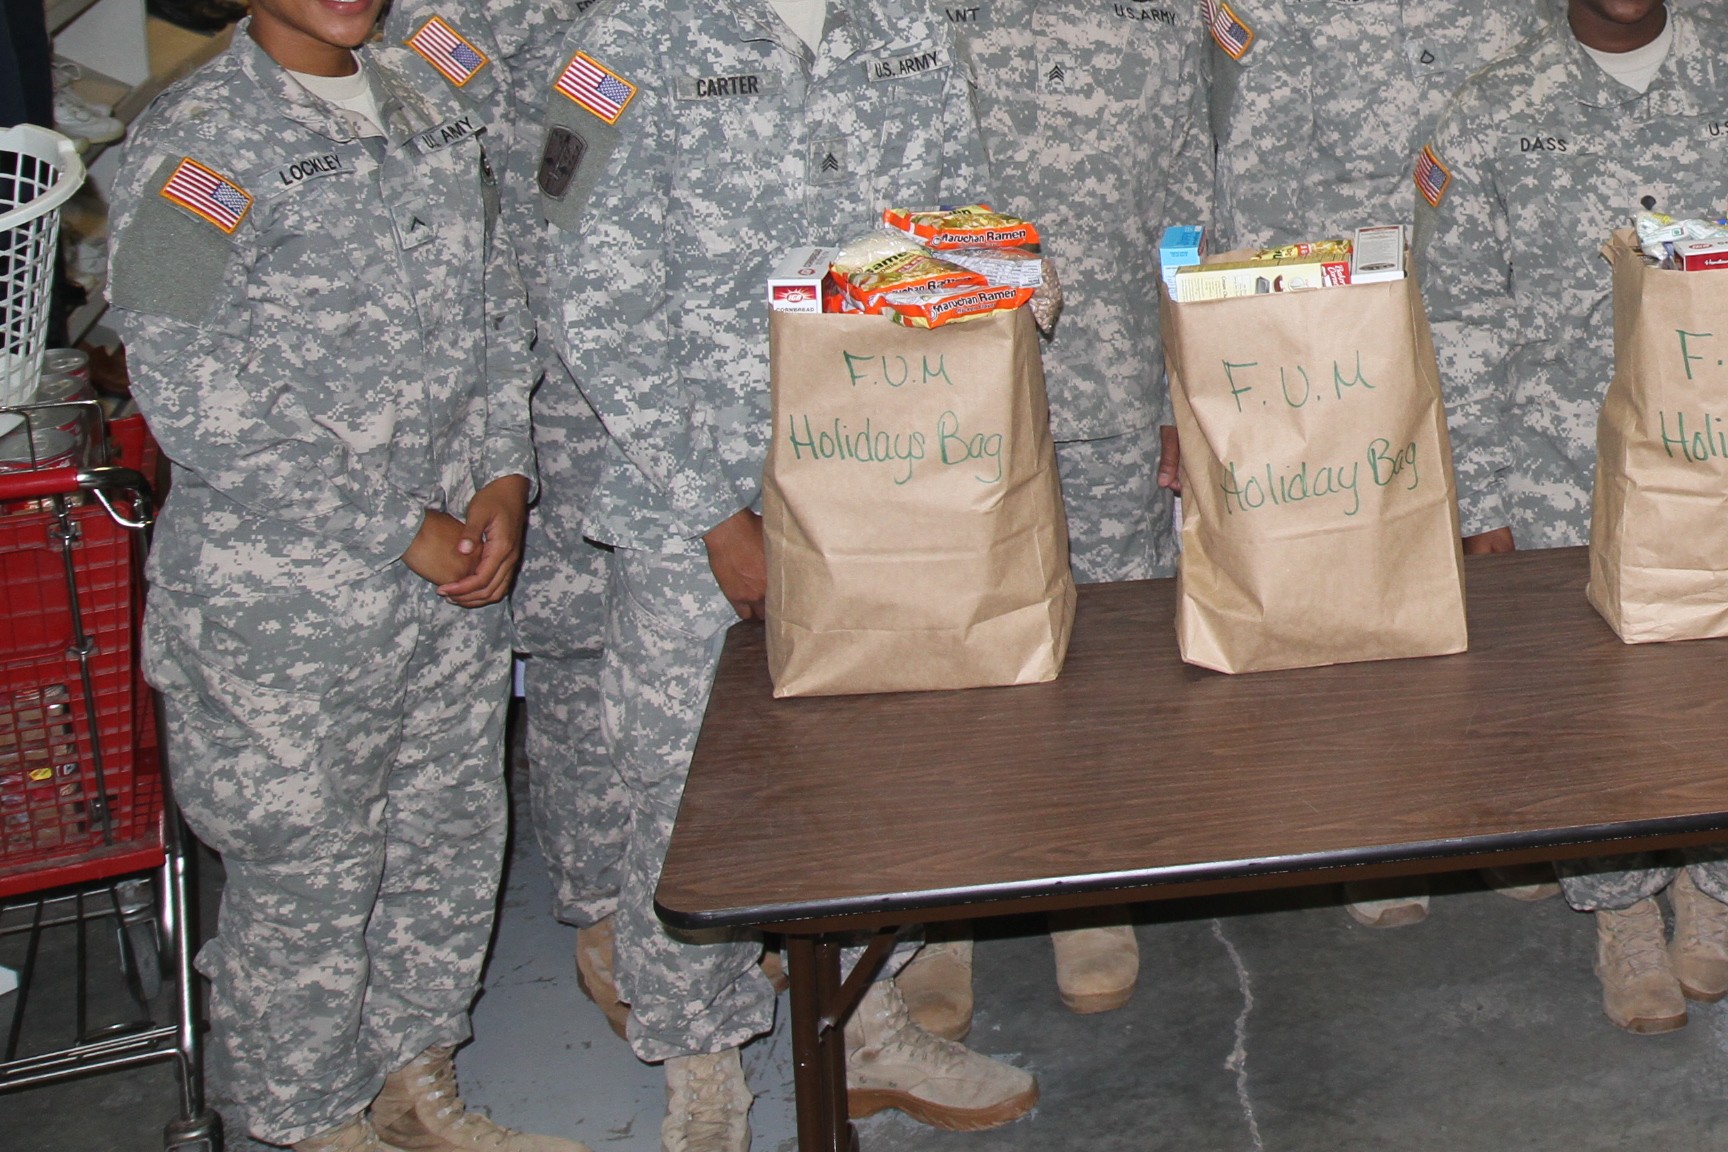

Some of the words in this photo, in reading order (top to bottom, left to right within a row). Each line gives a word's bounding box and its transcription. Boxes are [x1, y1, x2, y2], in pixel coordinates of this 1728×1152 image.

[1141, 8, 1177, 26] ARMY
[874, 62, 896, 78] U.S.
[899, 51, 939, 73] ARMY
[696, 74, 760, 97] CARTER
[1520, 137, 1567, 152] DASS
[279, 154, 343, 186] LOCKLEY
[986, 229, 1026, 242] Ramen
[932, 296, 978, 313] Maruchan
[978, 288, 1017, 303] Ramen
[937, 410, 1003, 484] Bag
[1220, 460, 1360, 516] Holiday
[1367, 437, 1419, 491] Bag
